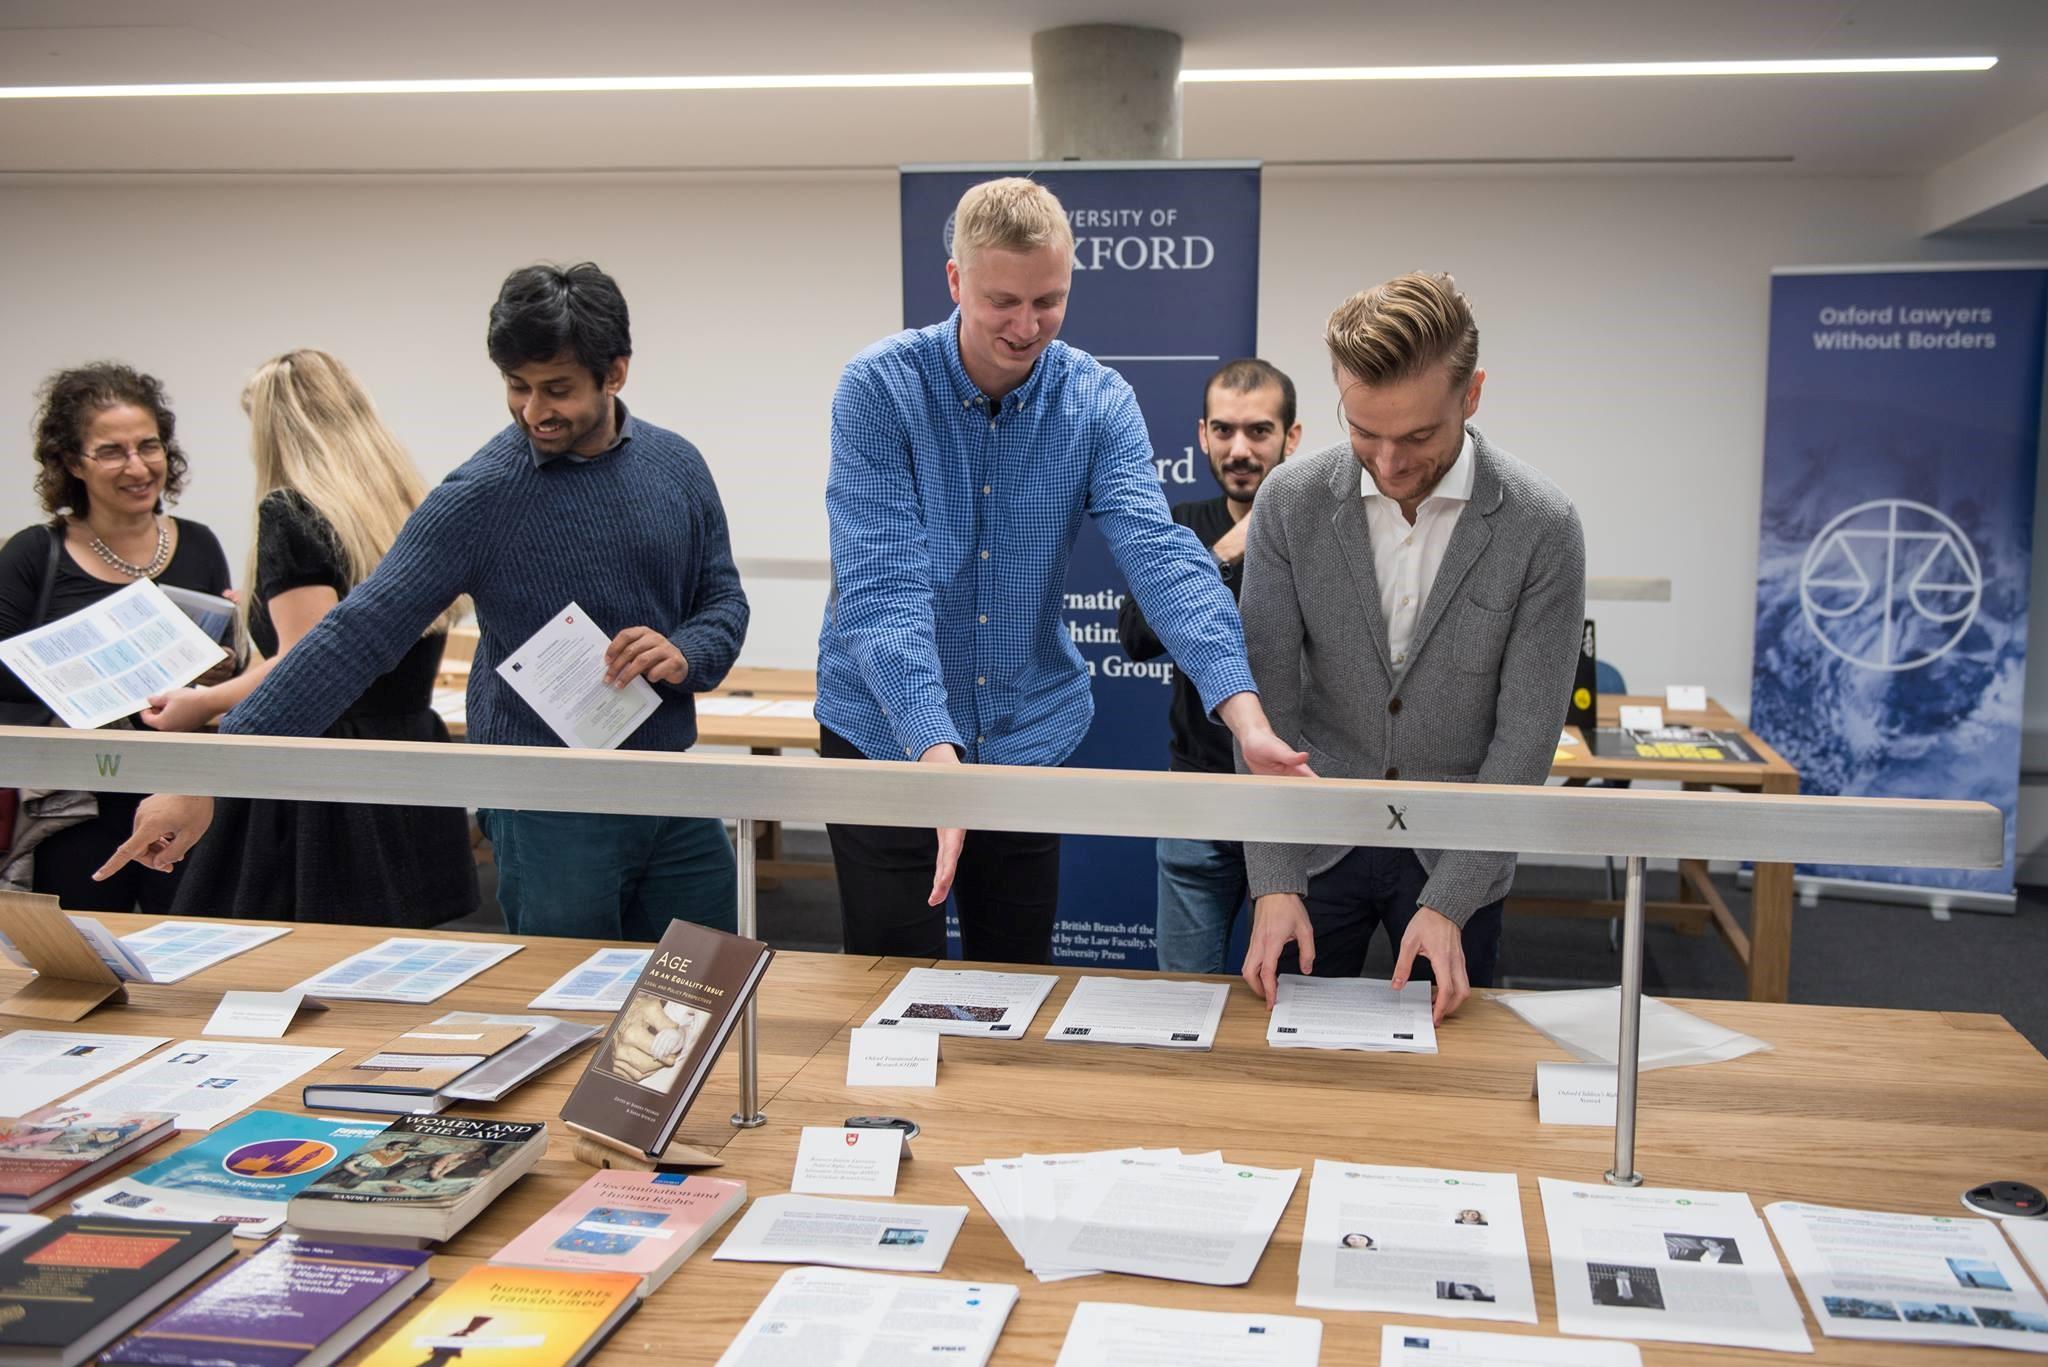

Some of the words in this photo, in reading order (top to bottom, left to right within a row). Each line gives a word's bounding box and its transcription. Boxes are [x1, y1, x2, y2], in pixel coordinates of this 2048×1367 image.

[1151, 209, 1178, 227] OF
[1073, 236, 1215, 271] XFORD
[1820, 305, 1892, 326] Oxford
[1900, 305, 1992, 328] Lawyers
[1813, 330, 1902, 350] Without
[1908, 330, 1997, 350] Borders
[1102, 655, 1174, 686] Group
[96, 753, 122, 777] W
[1387, 804, 1408, 830] X
[1061, 921, 1092, 932] British
[1093, 922, 1126, 933] Branch
[1128, 923, 1139, 934] of
[1139, 925, 1155, 935] the
[1061, 934, 1072, 946] by
[1074, 935, 1089, 945] the
[1091, 936, 1110, 946] Law
[656, 952, 692, 973] AGE
[1054, 947, 1100, 960] University
[1101, 949, 1126, 960] Press
[405, 1116, 481, 1131] WOMEN
[484, 1122, 533, 1134] AND
[413, 1124, 454, 1136] THE
[463, 1129, 508, 1140] LAW
[594, 1182, 689, 1198] Discrimination
[691, 1191, 721, 1200] and
[600, 1191, 651, 1204] Human
[653, 1195, 695, 1207] Rights
[489, 1282, 553, 1296] human
[560, 1287, 614, 1302] rights
[490, 1293, 607, 1308] transformed
